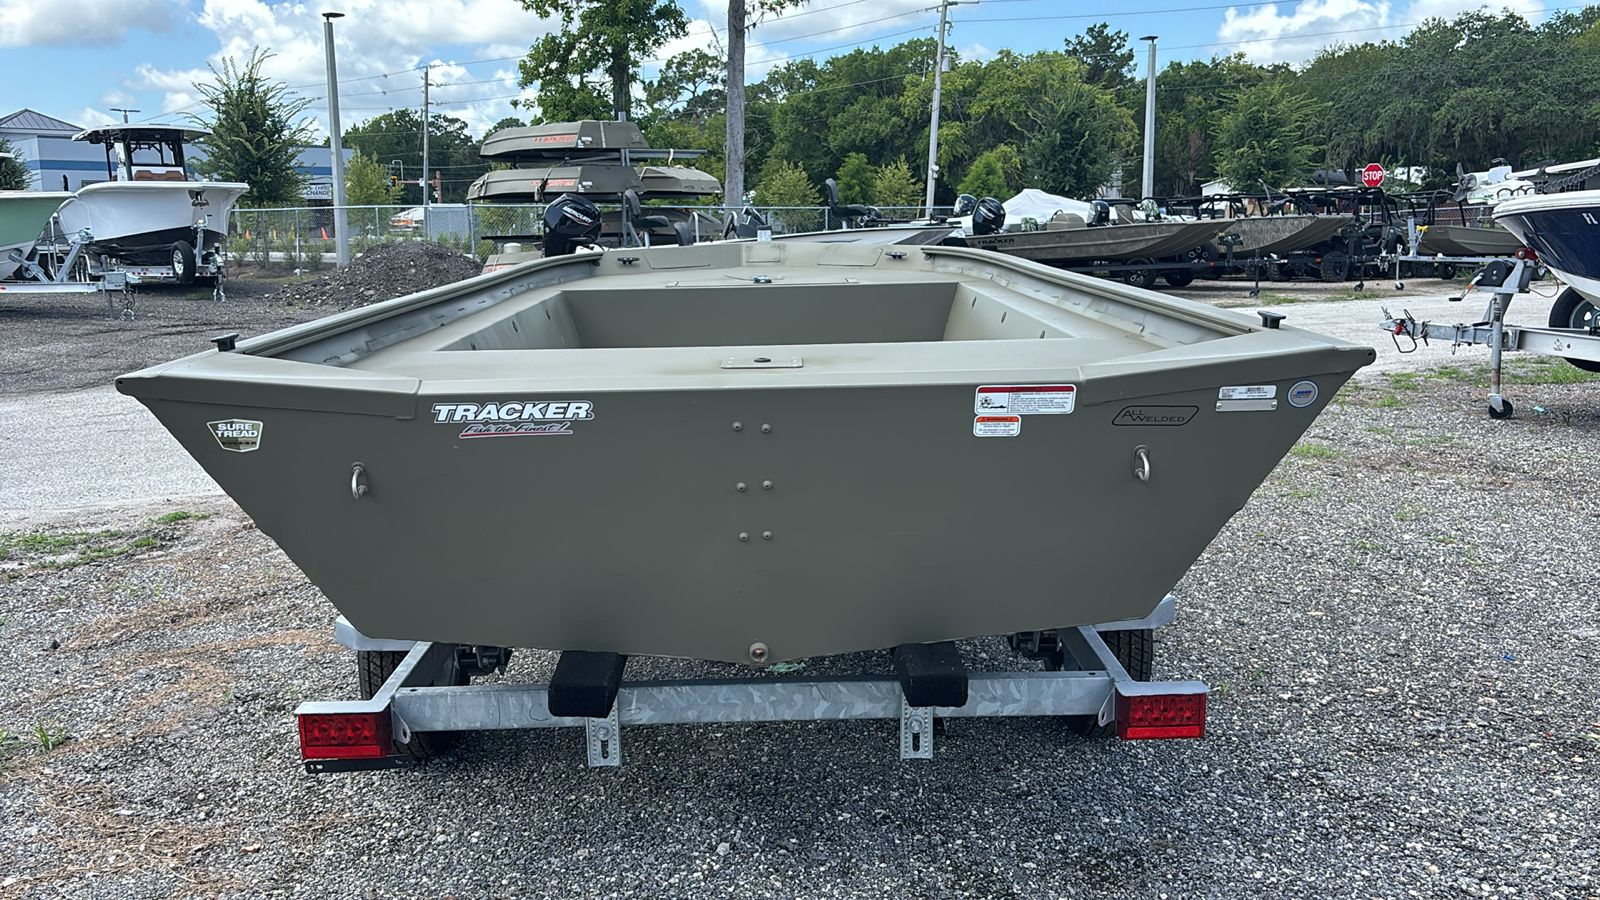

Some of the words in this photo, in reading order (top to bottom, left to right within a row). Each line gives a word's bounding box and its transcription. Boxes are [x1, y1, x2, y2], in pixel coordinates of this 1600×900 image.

[1364, 171, 1383, 180] STOP
[562, 206, 594, 223] MERCURY
[1581, 213, 1599, 225] FL
[433, 402, 591, 421] TRACKER
[1121, 410, 1146, 418] ALL
[215, 430, 258, 438] TREAD
[464, 425, 491, 434] Fish
[494, 424, 514, 432] the
